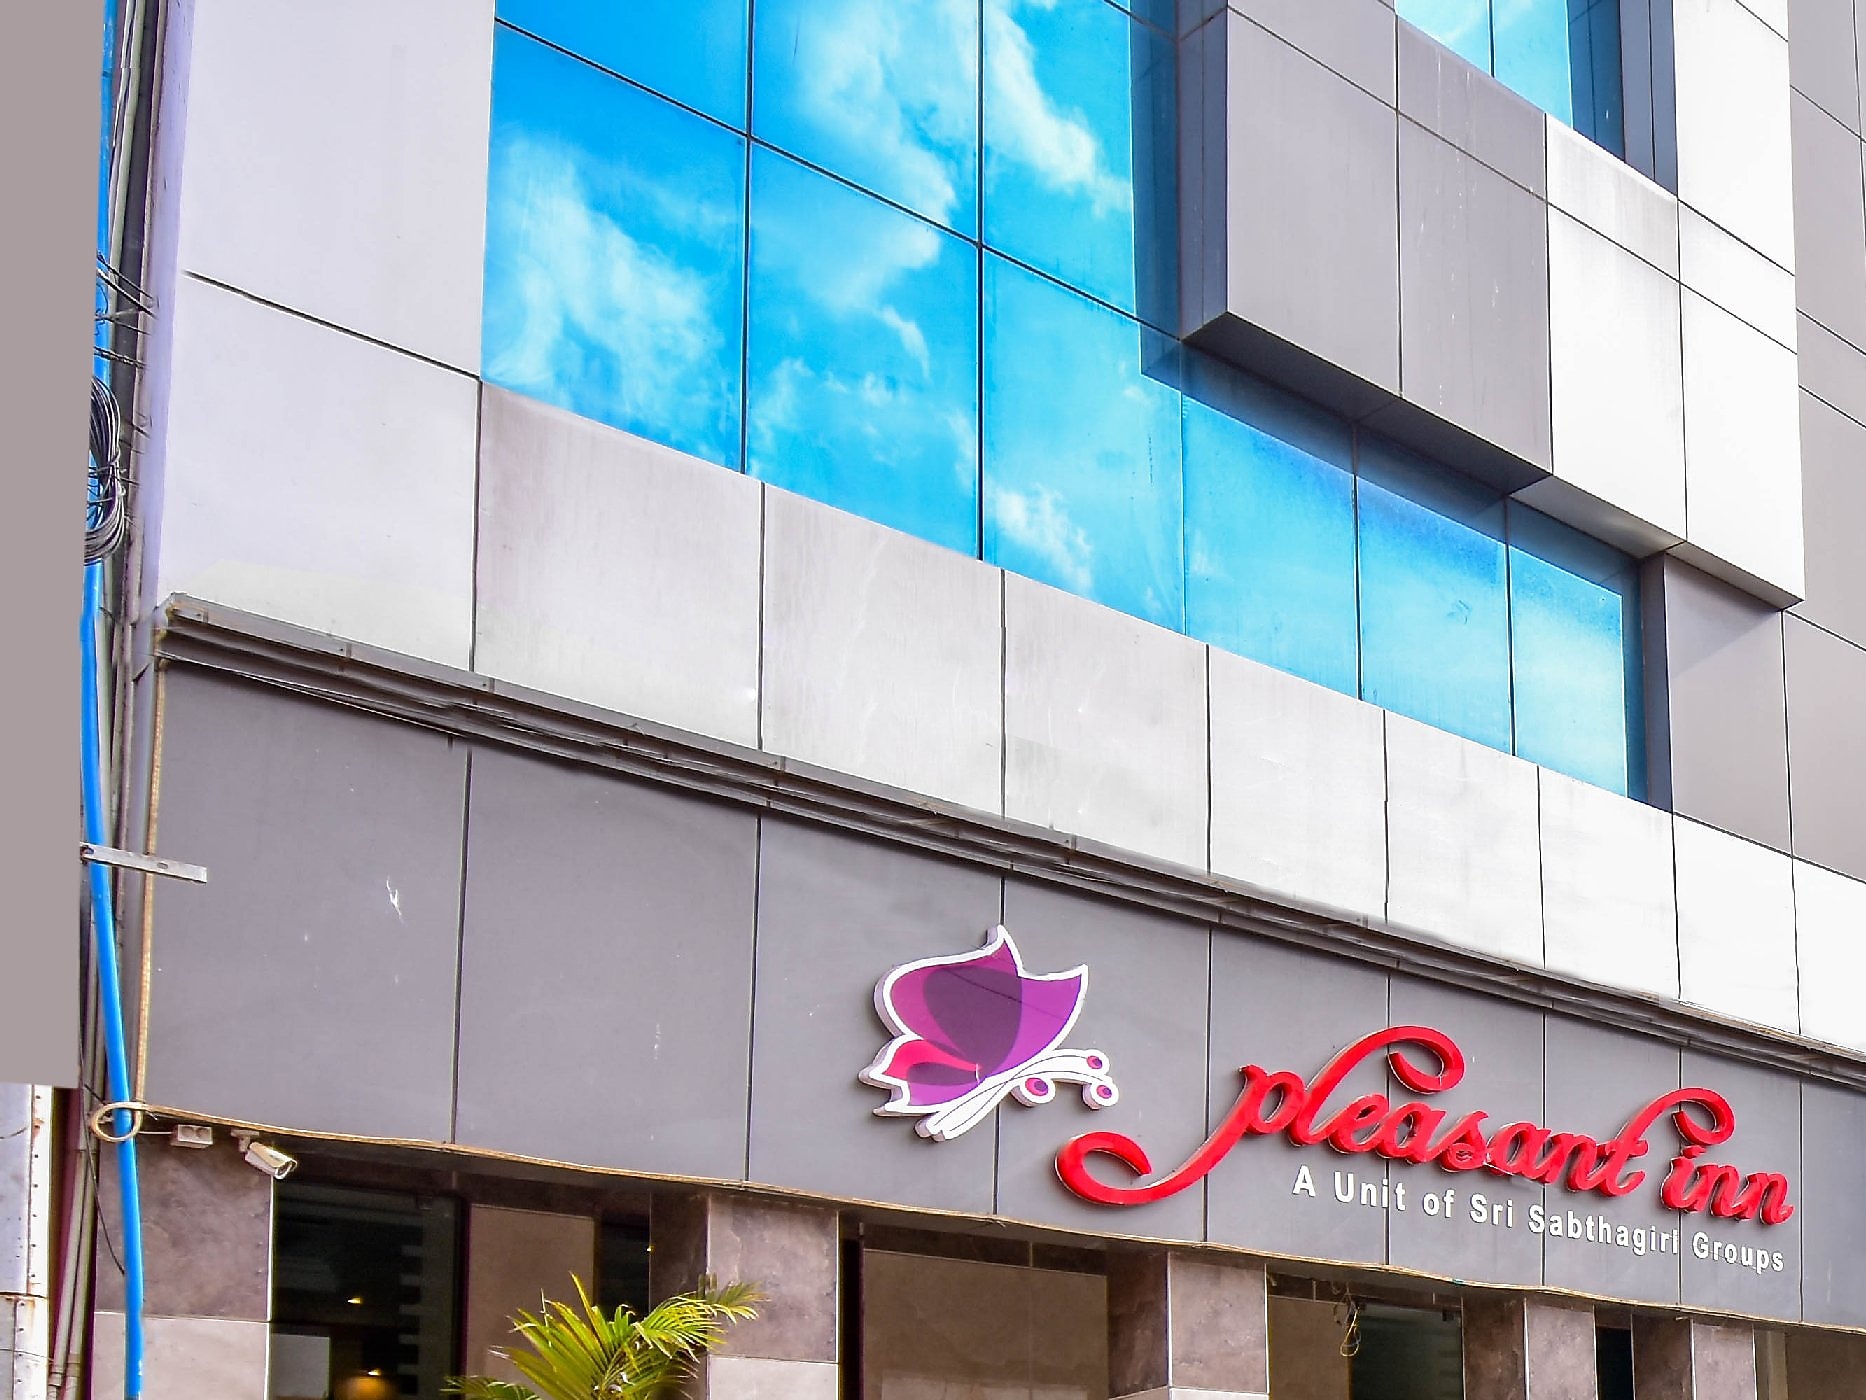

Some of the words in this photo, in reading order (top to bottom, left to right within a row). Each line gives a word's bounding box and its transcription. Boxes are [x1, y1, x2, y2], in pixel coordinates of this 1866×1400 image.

[1056, 1026, 1734, 1205] pleasant
[1660, 1140, 1794, 1226] inn
[1292, 1166, 1317, 1197] A
[1332, 1170, 1408, 1213] Unit
[1422, 1189, 1457, 1221] of
[1468, 1192, 1516, 1229] Sri
[1527, 1203, 1680, 1259] Sabthagiri
[1692, 1230, 1786, 1275] Groups
